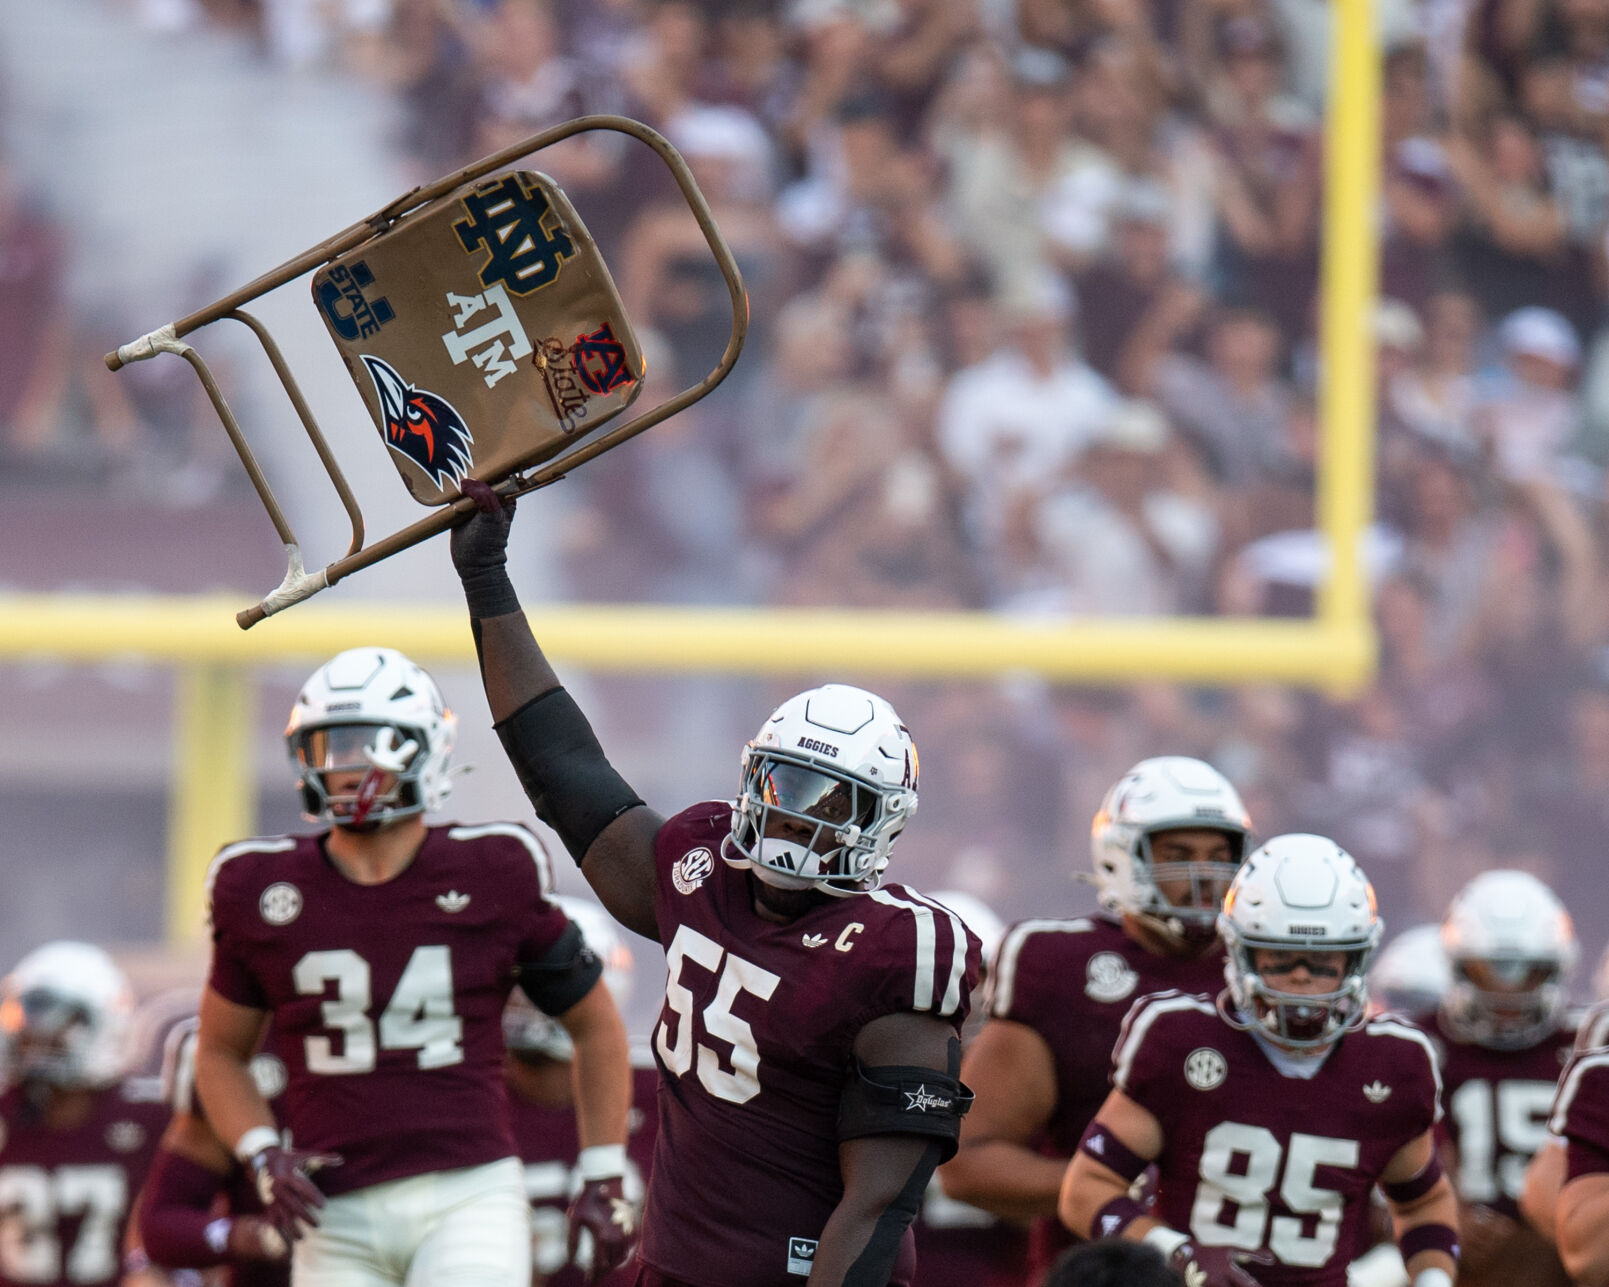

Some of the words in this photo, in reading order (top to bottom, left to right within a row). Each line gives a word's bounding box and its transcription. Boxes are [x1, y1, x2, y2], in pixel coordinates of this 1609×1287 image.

[328, 264, 381, 340] STATE
[797, 736, 839, 758] AGGIES
[834, 922, 865, 953] C
[291, 944, 465, 1074] 34
[656, 923, 781, 1104] 55
[916, 1095, 949, 1108] Douglas
[1451, 1078, 1558, 1201] 15
[0, 1163, 129, 1286] 37
[1189, 1120, 1361, 1268] 85
